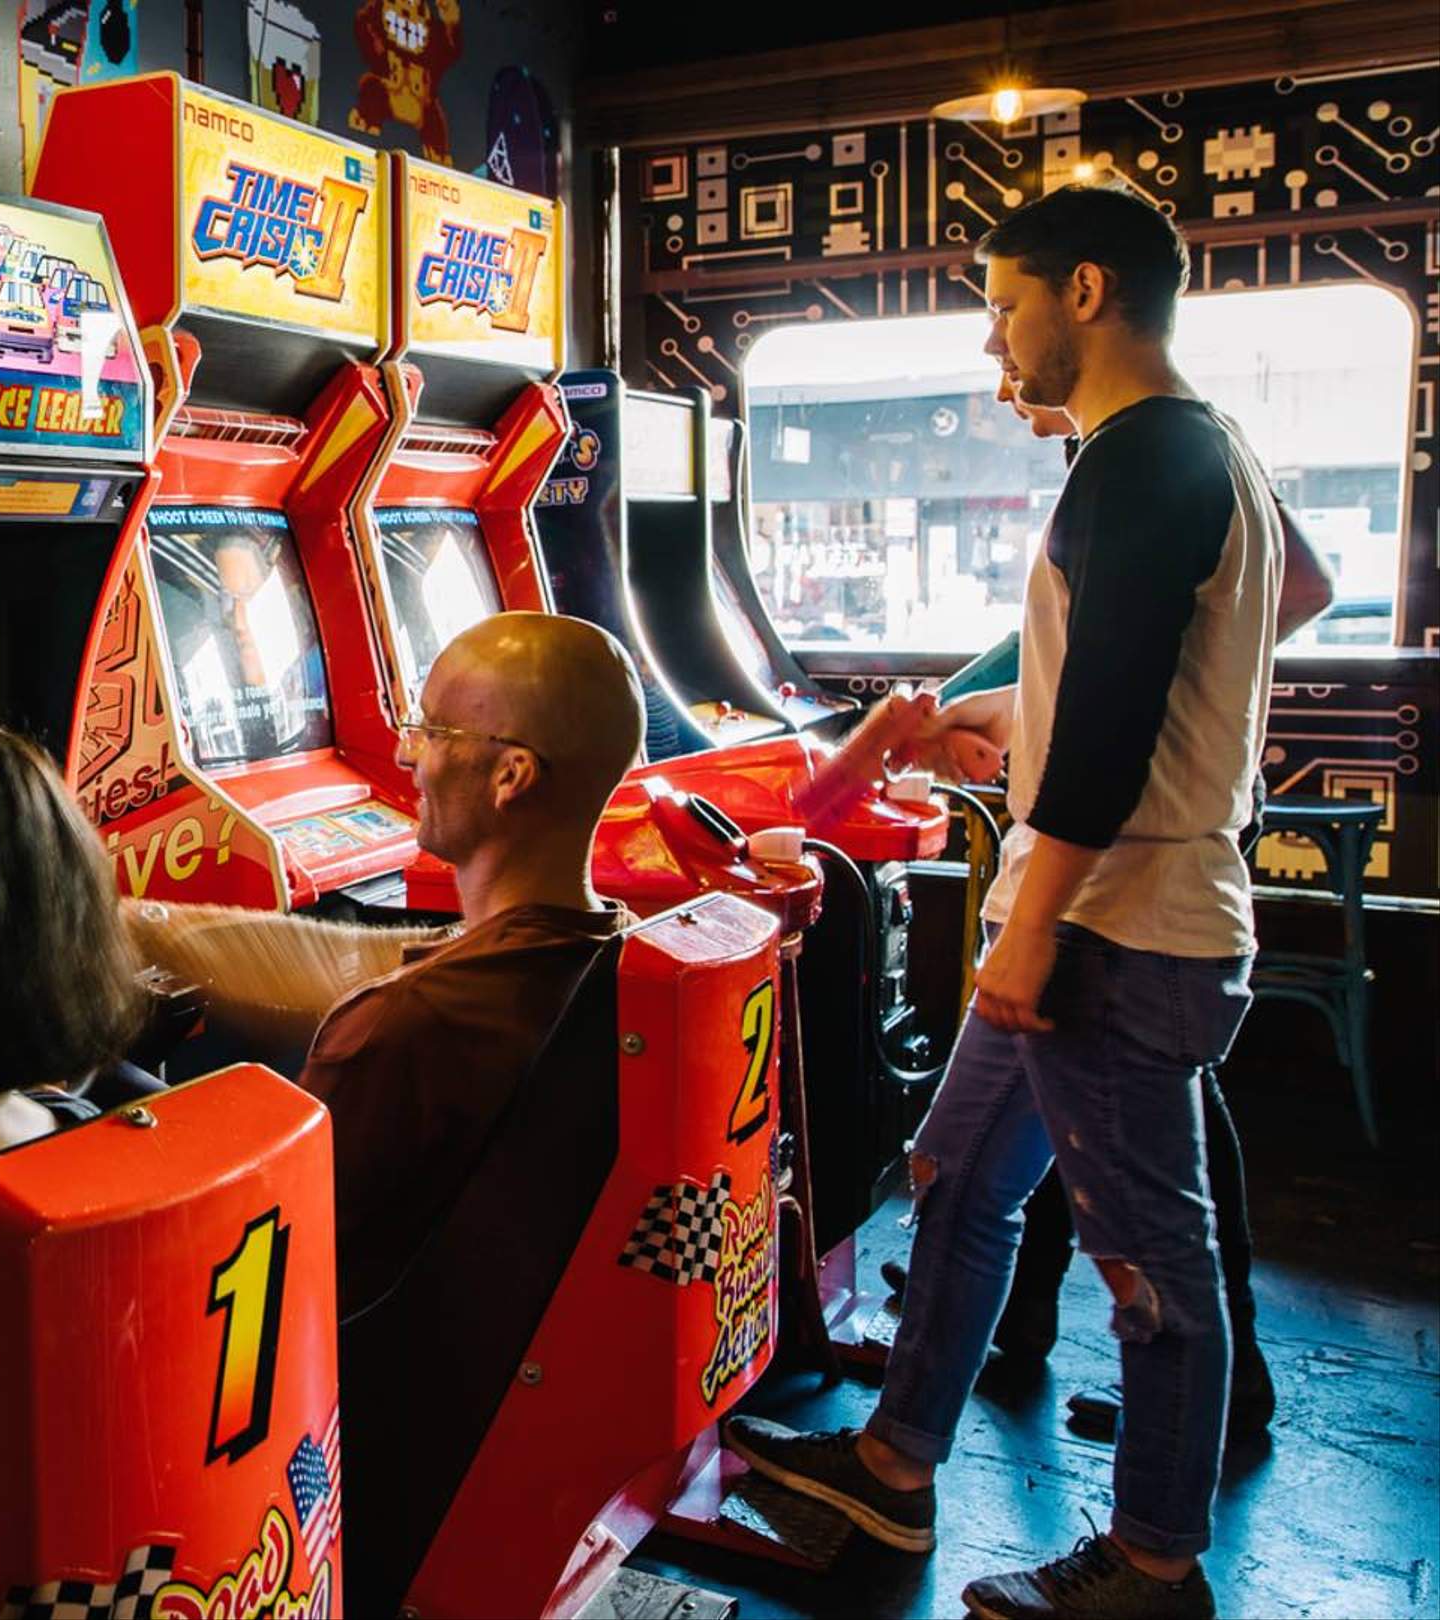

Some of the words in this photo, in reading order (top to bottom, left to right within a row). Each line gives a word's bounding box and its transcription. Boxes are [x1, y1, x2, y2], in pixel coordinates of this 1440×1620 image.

[184, 101, 254, 143] namco
[226, 160, 318, 226] TIME
[409, 175, 460, 204] namco
[440, 219, 510, 269] TIME
[725, 978, 774, 1144] 2
[204, 1205, 290, 1467] 1
